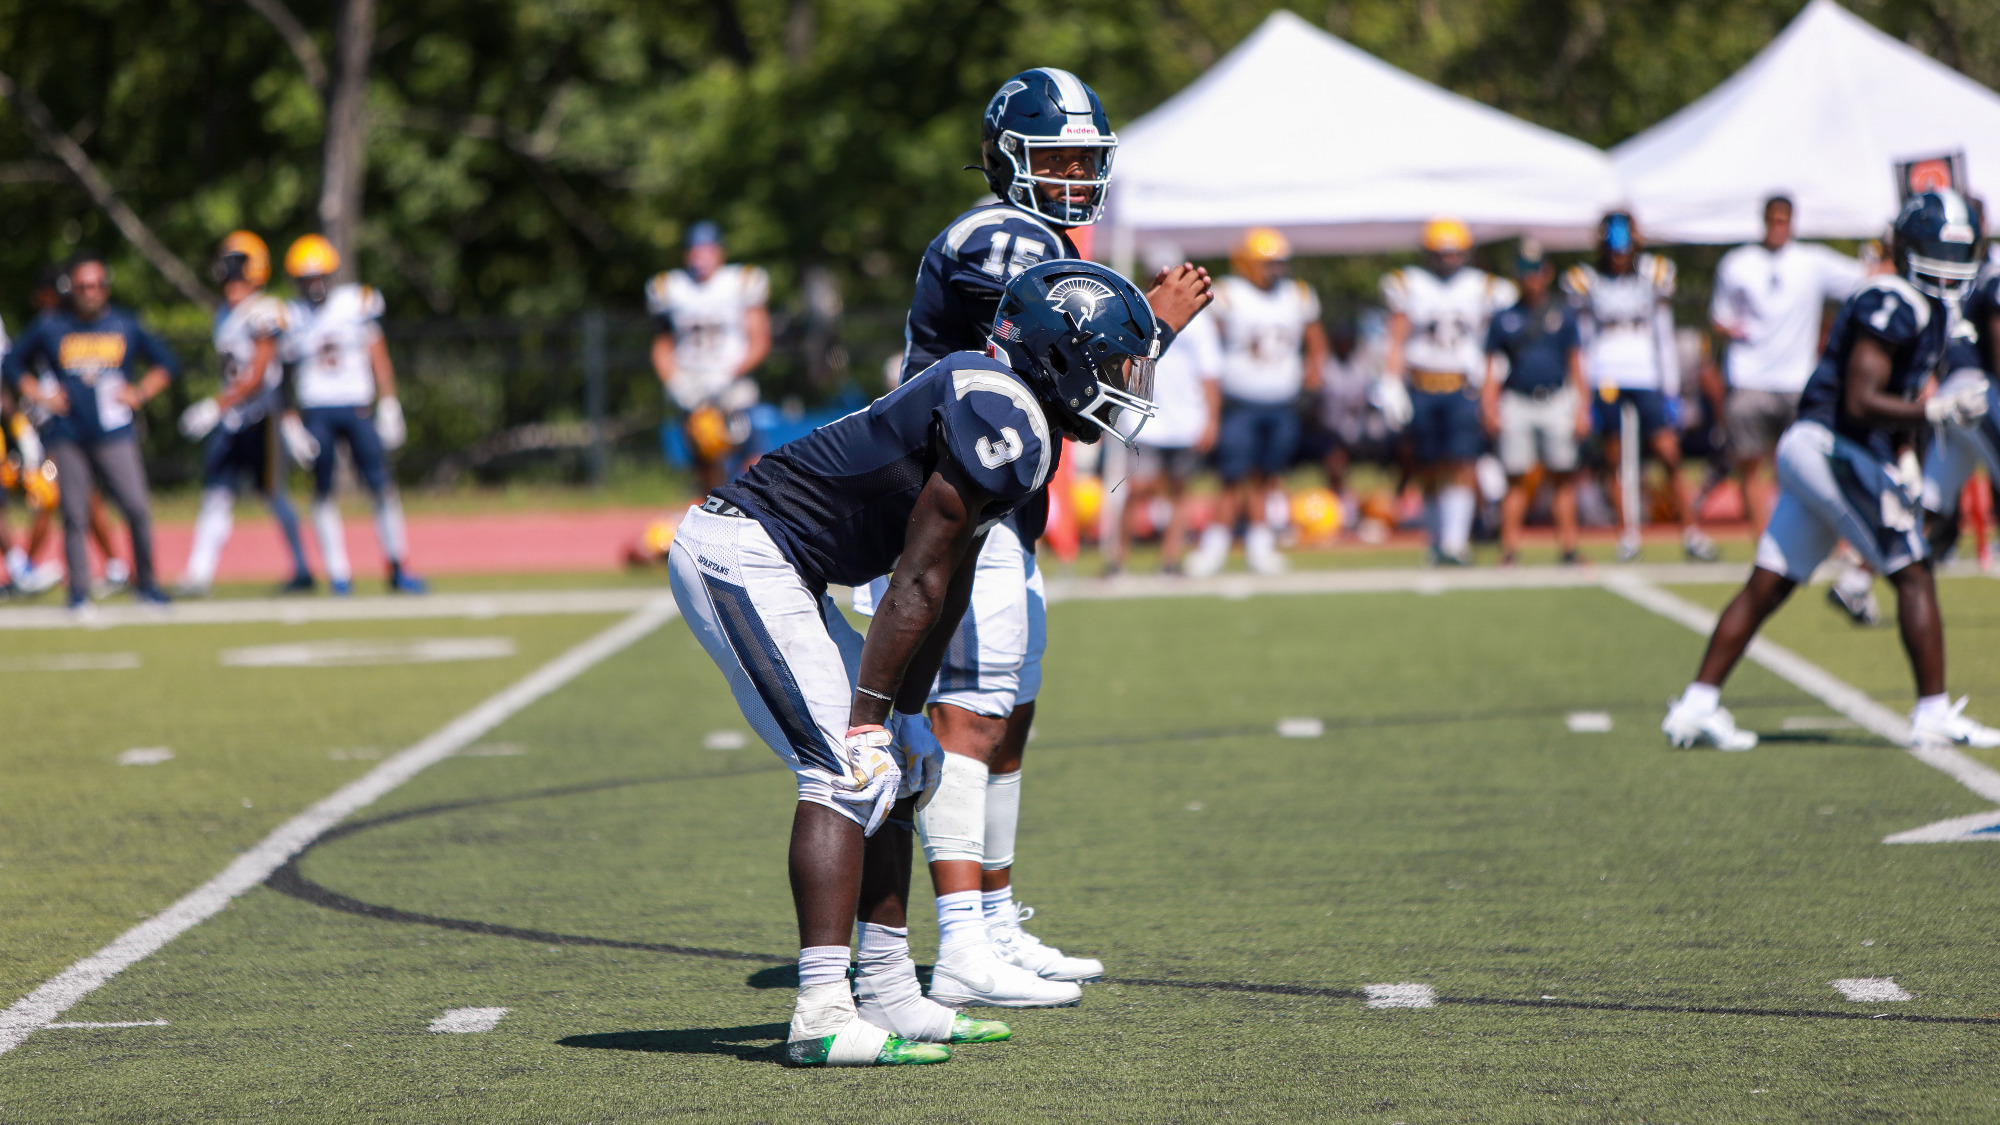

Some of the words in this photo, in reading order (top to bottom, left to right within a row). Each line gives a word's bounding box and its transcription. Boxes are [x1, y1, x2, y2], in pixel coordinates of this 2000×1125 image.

[981, 231, 1046, 279] 15
[974, 426, 1024, 470] 3
[697, 554, 730, 576] SPARTANS
